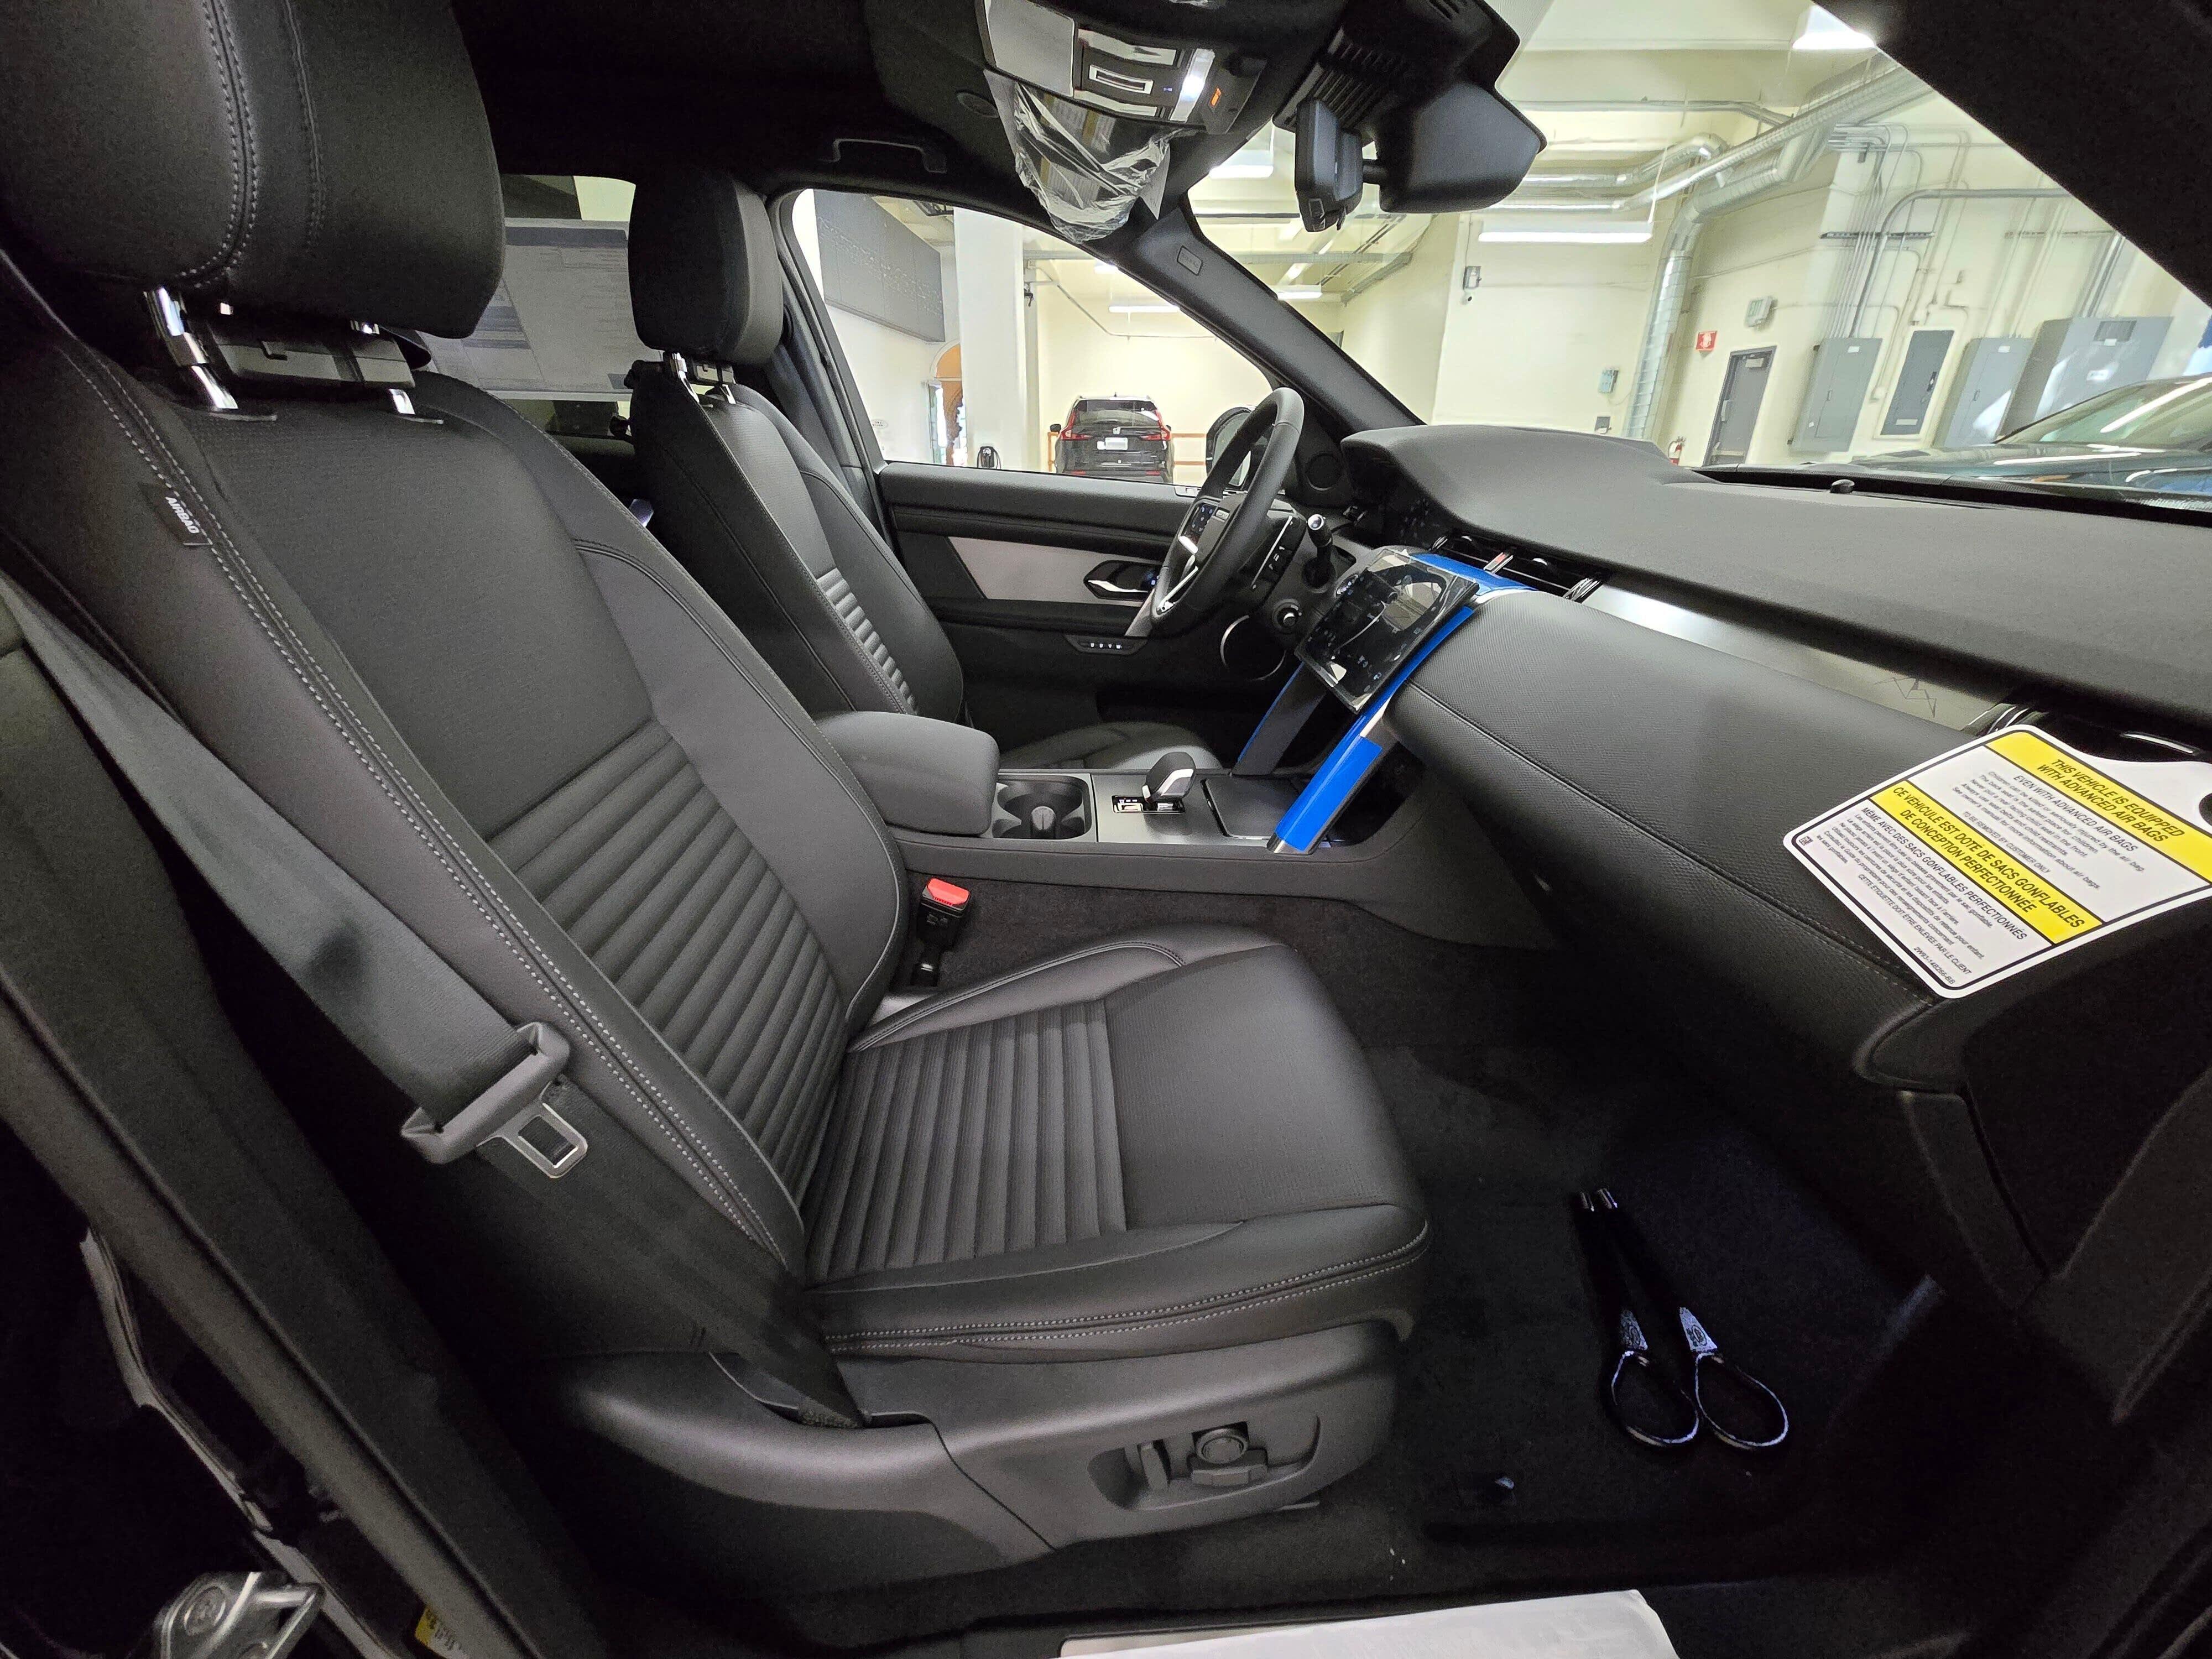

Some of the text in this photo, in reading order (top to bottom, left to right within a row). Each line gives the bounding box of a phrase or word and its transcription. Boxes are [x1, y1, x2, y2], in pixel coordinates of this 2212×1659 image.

[2013, 775, 2138, 852] EVEN WITH ADVANCED AIR BAGS
[2037, 764, 2169, 842] WITH ADVANCED AIR BAGS
[2051, 759, 2185, 836] THIS VEHICLE IS EQUIPPED
[1861, 807, 2027, 940] MÊME AVEC DES SACS GONFLABLES PERFECTIONNÉS
[1893, 787, 2085, 927] CE VÉHICULE EST DOTÉ DE SACS GONFLABLES
[1900, 810, 2037, 913] DE CONCEPTION PERFECTIONNÉE
[1976, 821, 2001, 838] REMOVED
[2006, 842, 2037, 863] CUSTOMER
[2033, 862, 2051, 873] ONLY
